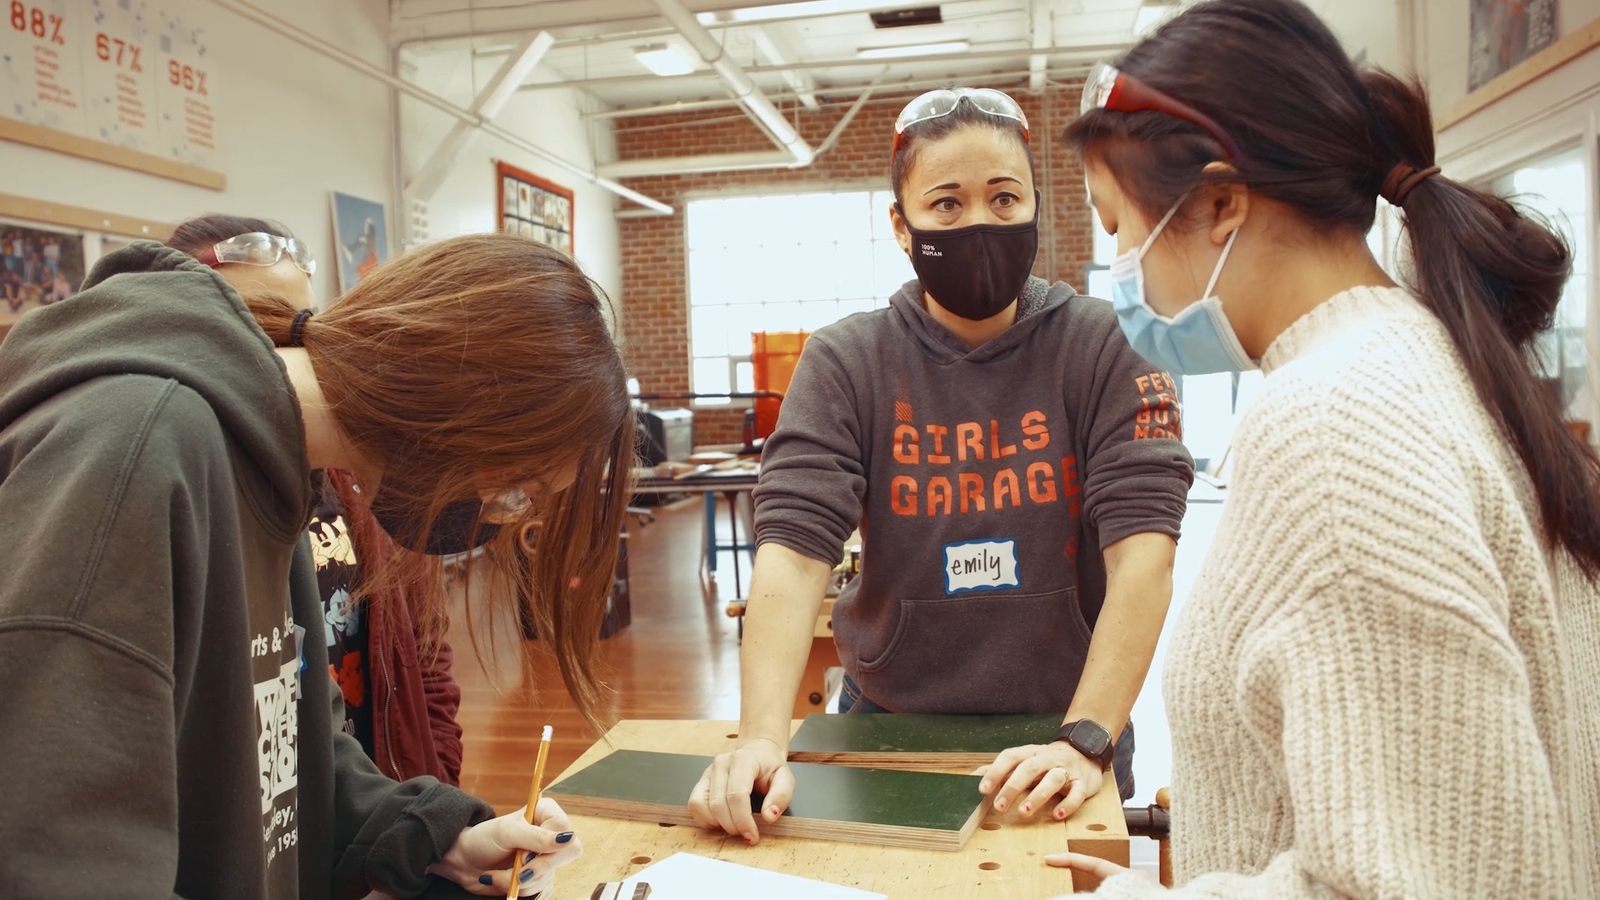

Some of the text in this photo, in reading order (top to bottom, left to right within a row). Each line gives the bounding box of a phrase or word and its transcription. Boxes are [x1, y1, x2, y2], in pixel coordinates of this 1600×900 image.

[10, 0, 65, 45] 88%
[95, 32, 143, 73] 67%
[168, 59, 208, 96] 96%
[1135, 372, 1176, 396] FEA
[893, 410, 1050, 465] GIRLS
[891, 454, 1080, 517] GARAGE
[951, 549, 1001, 581] emily
[251, 633, 268, 657] rts
[271, 626, 282, 653] &
